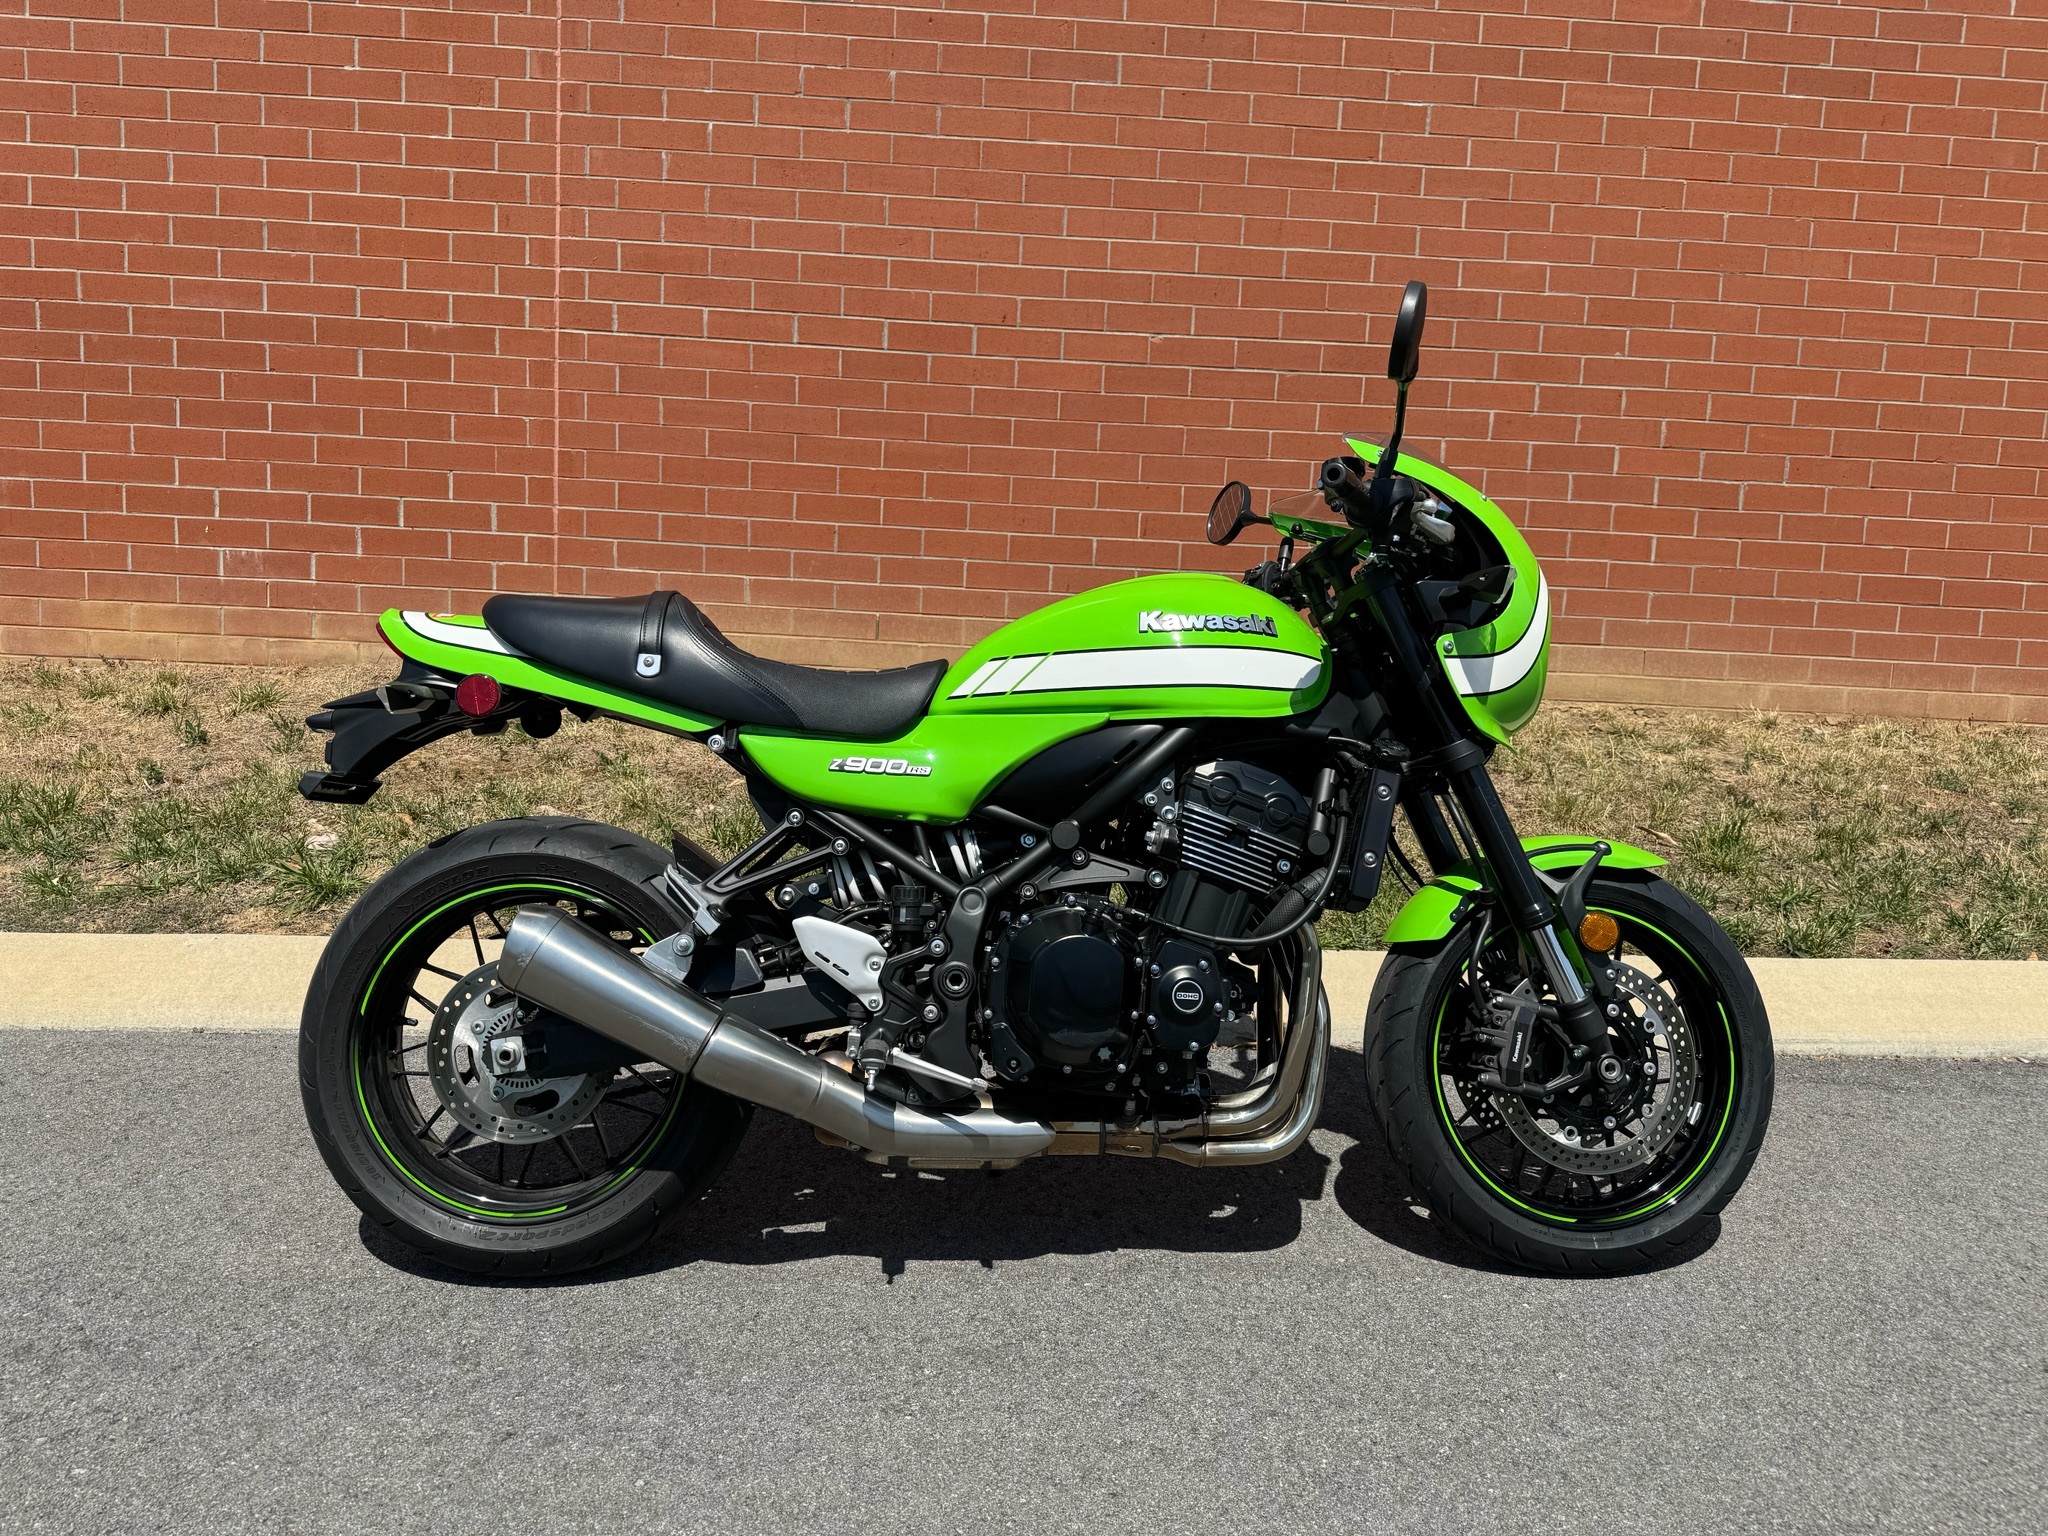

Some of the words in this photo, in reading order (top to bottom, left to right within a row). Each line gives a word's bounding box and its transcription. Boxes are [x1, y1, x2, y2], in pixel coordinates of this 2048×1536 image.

[1139, 610, 1278, 638] Kawasaki
[1177, 992, 1199, 1000] DOHC
[1511, 1031, 1523, 1063] Kawasaki
